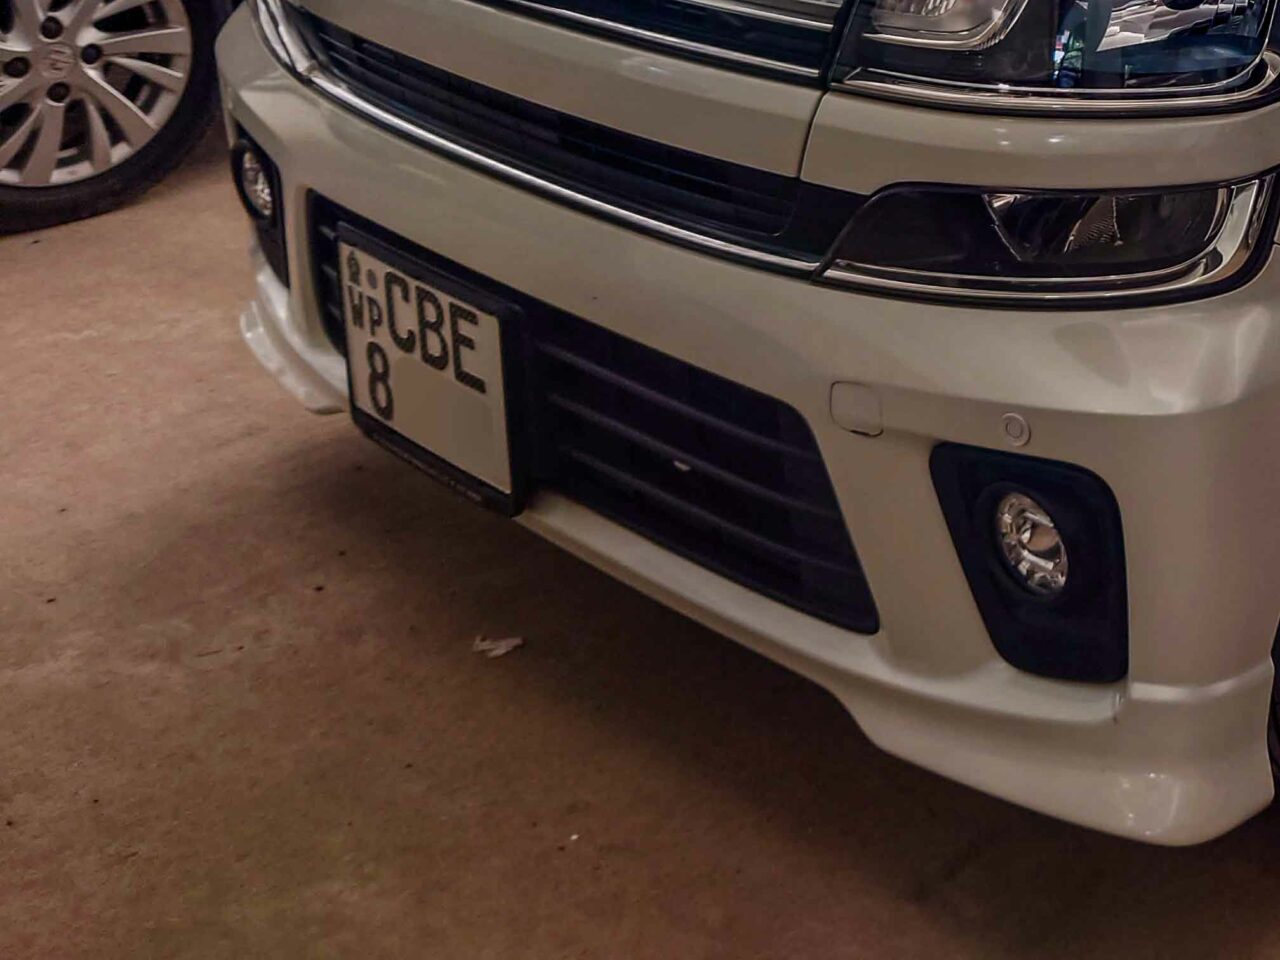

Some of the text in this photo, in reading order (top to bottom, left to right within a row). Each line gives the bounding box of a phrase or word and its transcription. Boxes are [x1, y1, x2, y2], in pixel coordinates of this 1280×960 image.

[347, 271, 487, 394] WP CBE
[366, 341, 394, 421] 8
